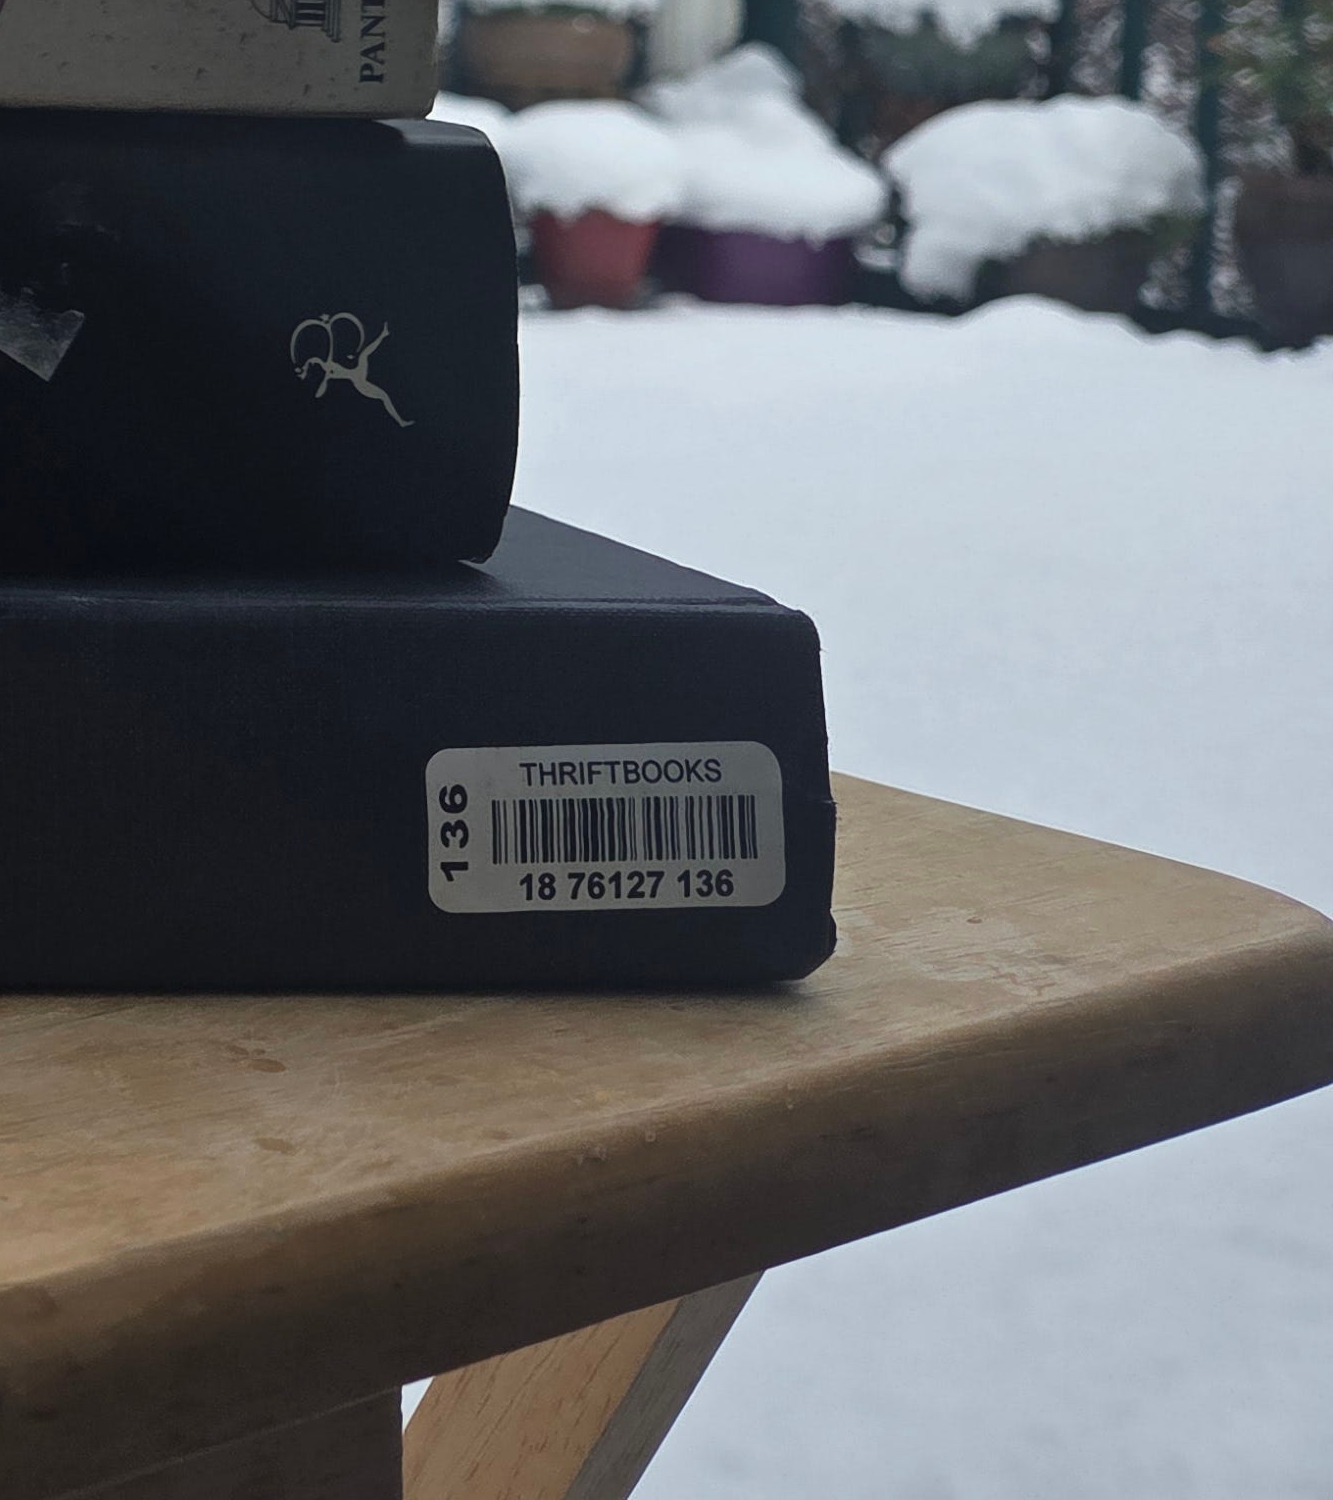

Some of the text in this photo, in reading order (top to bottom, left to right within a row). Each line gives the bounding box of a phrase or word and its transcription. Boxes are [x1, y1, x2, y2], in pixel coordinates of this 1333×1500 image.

[519, 759, 723, 787] THRIFTBOOKS
[519, 868, 734, 901] 18 76127 136
